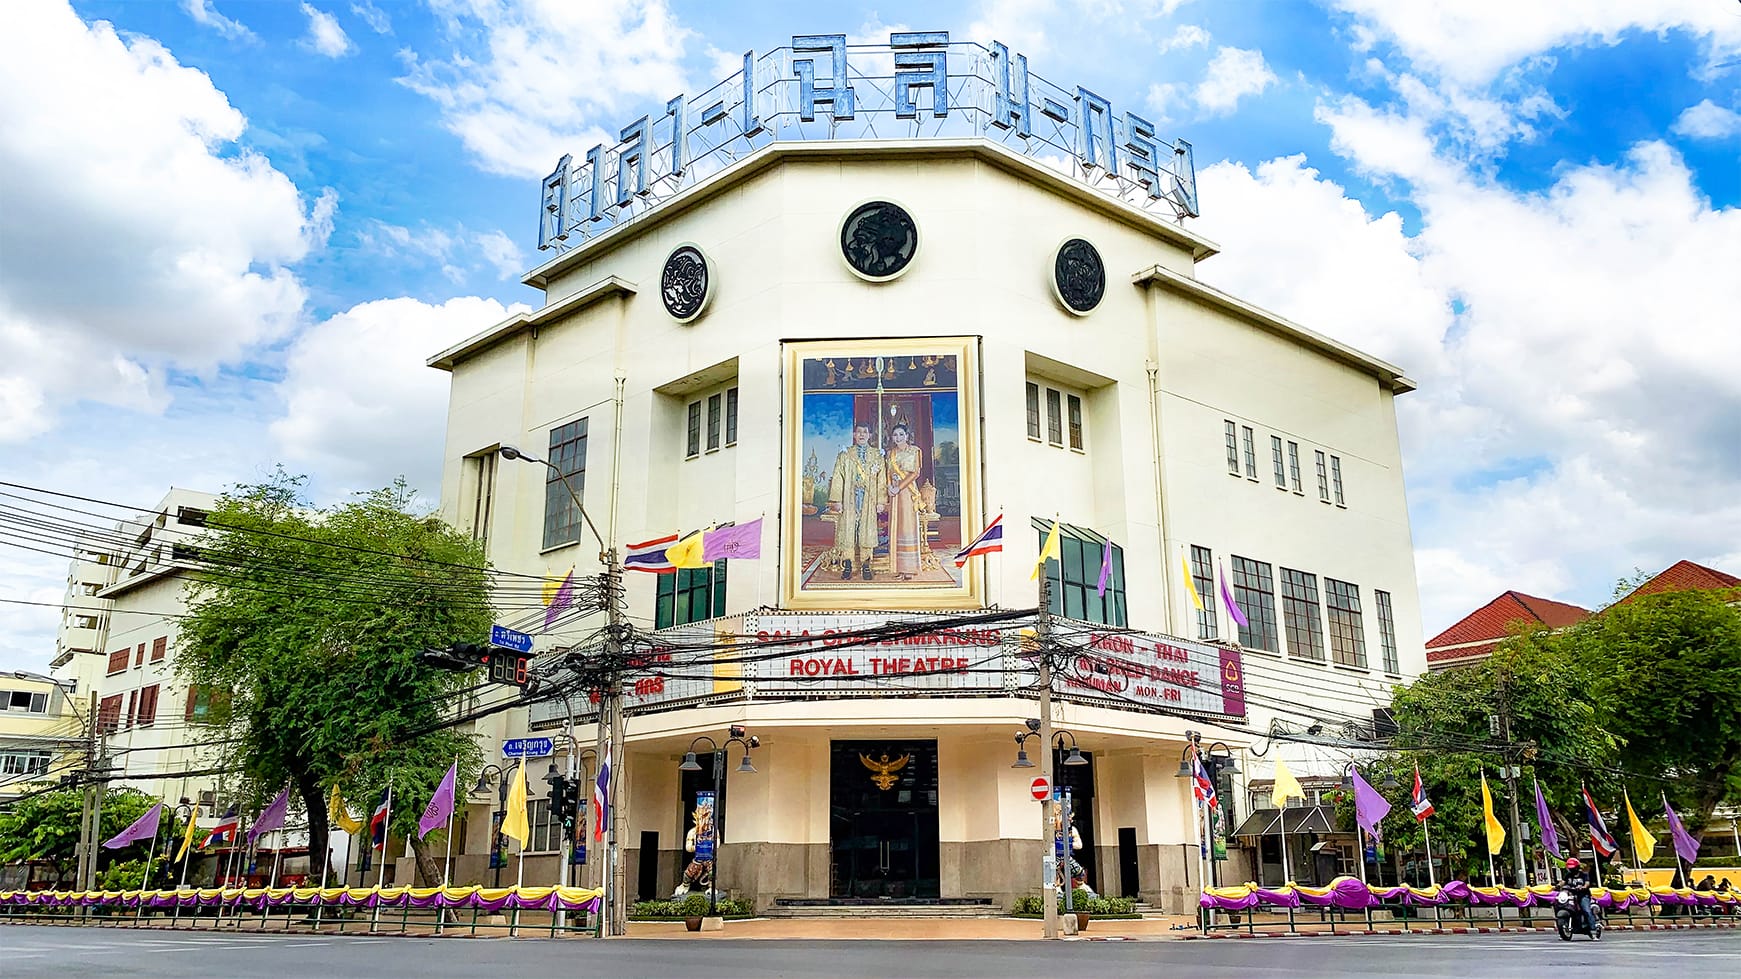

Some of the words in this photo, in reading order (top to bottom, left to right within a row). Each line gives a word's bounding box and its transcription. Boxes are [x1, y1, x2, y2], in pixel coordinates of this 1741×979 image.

[823, 628, 1000, 646] CHAMKRUNG
[1155, 643, 1189, 663] THAI
[790, 658, 860, 676] ROYAL
[869, 657, 969, 676] THEATRE
[1079, 656, 1145, 679] MSKED
[1149, 664, 1200, 688] DANCE
